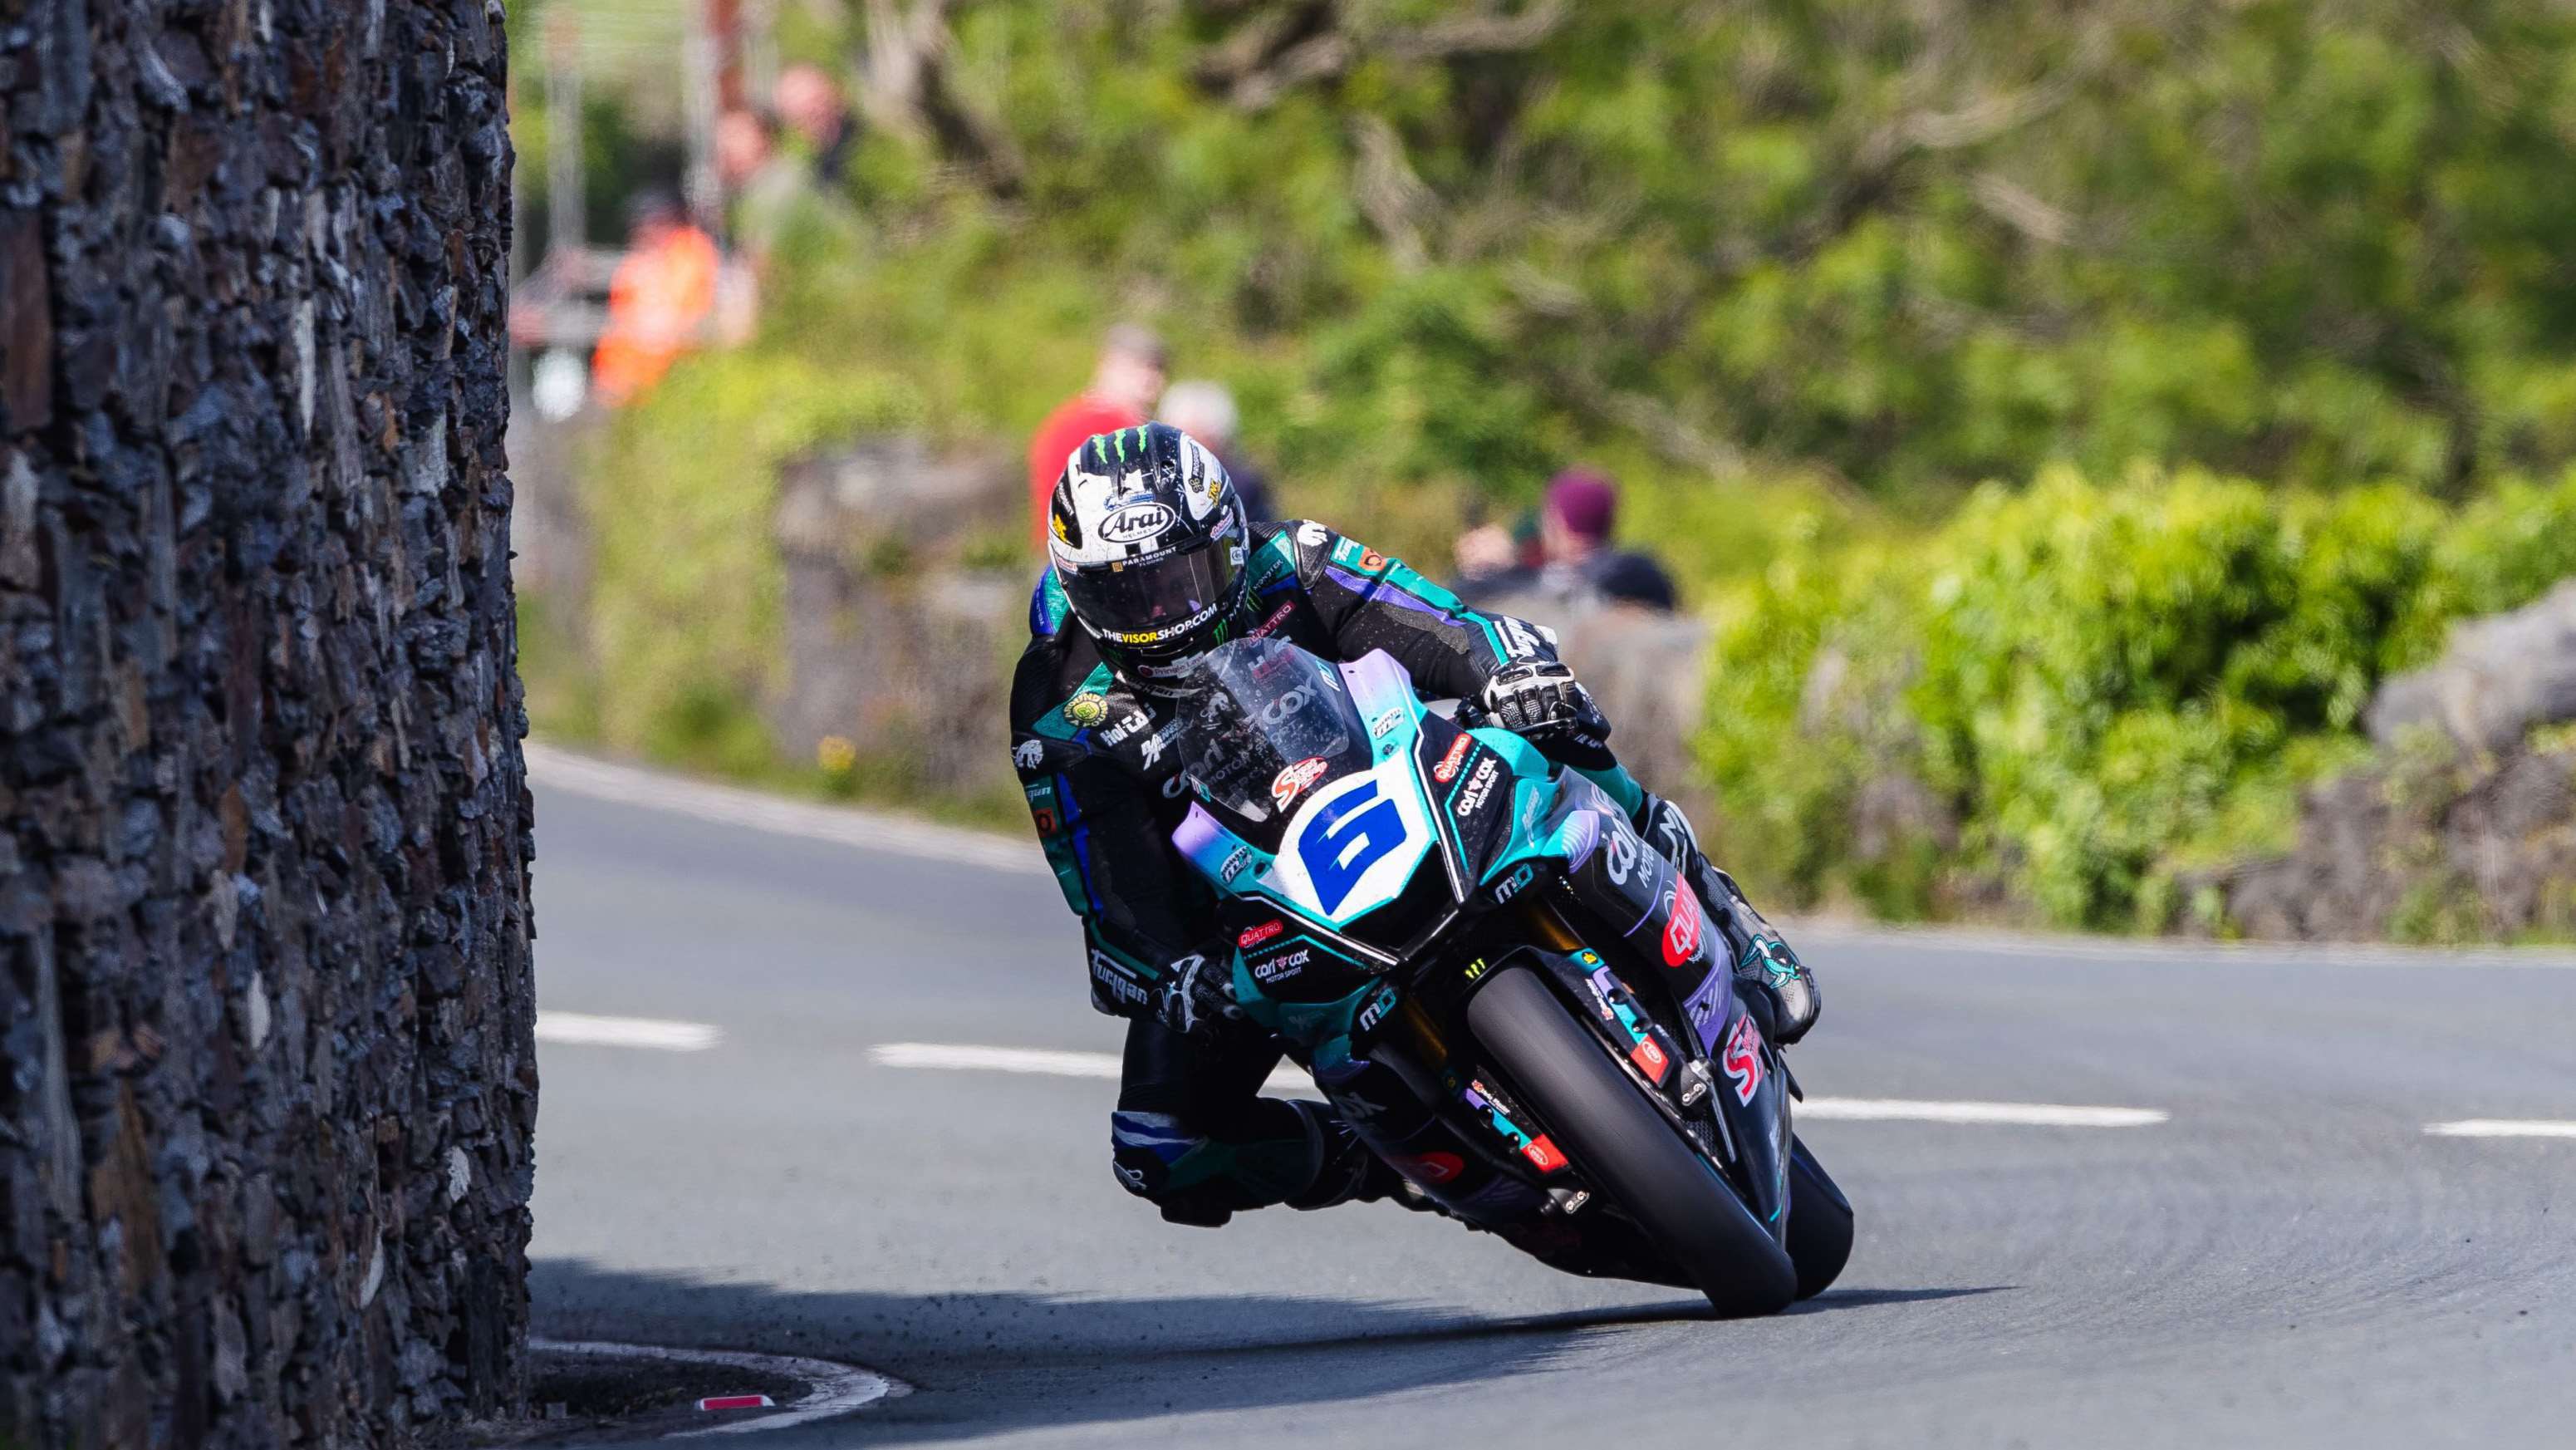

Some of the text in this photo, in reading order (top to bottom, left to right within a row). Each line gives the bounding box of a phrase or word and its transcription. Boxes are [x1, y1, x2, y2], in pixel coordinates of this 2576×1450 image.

[1104, 506, 1165, 538] Arai
[1122, 547, 1177, 567] PARAMOUNT
[1102, 602, 1218, 644] THEVISORSHOP.COM
[1436, 736, 1469, 780] QUATTRO
[1457, 757, 1498, 817] carl cox
[1474, 770, 1499, 809] MOTOR SPORT
[1298, 779, 1407, 916] 6
[1239, 922, 1280, 945] QUATTRO
[1254, 949, 1310, 979] carl cox
[1266, 966, 1302, 984] MOTOR SPORT
